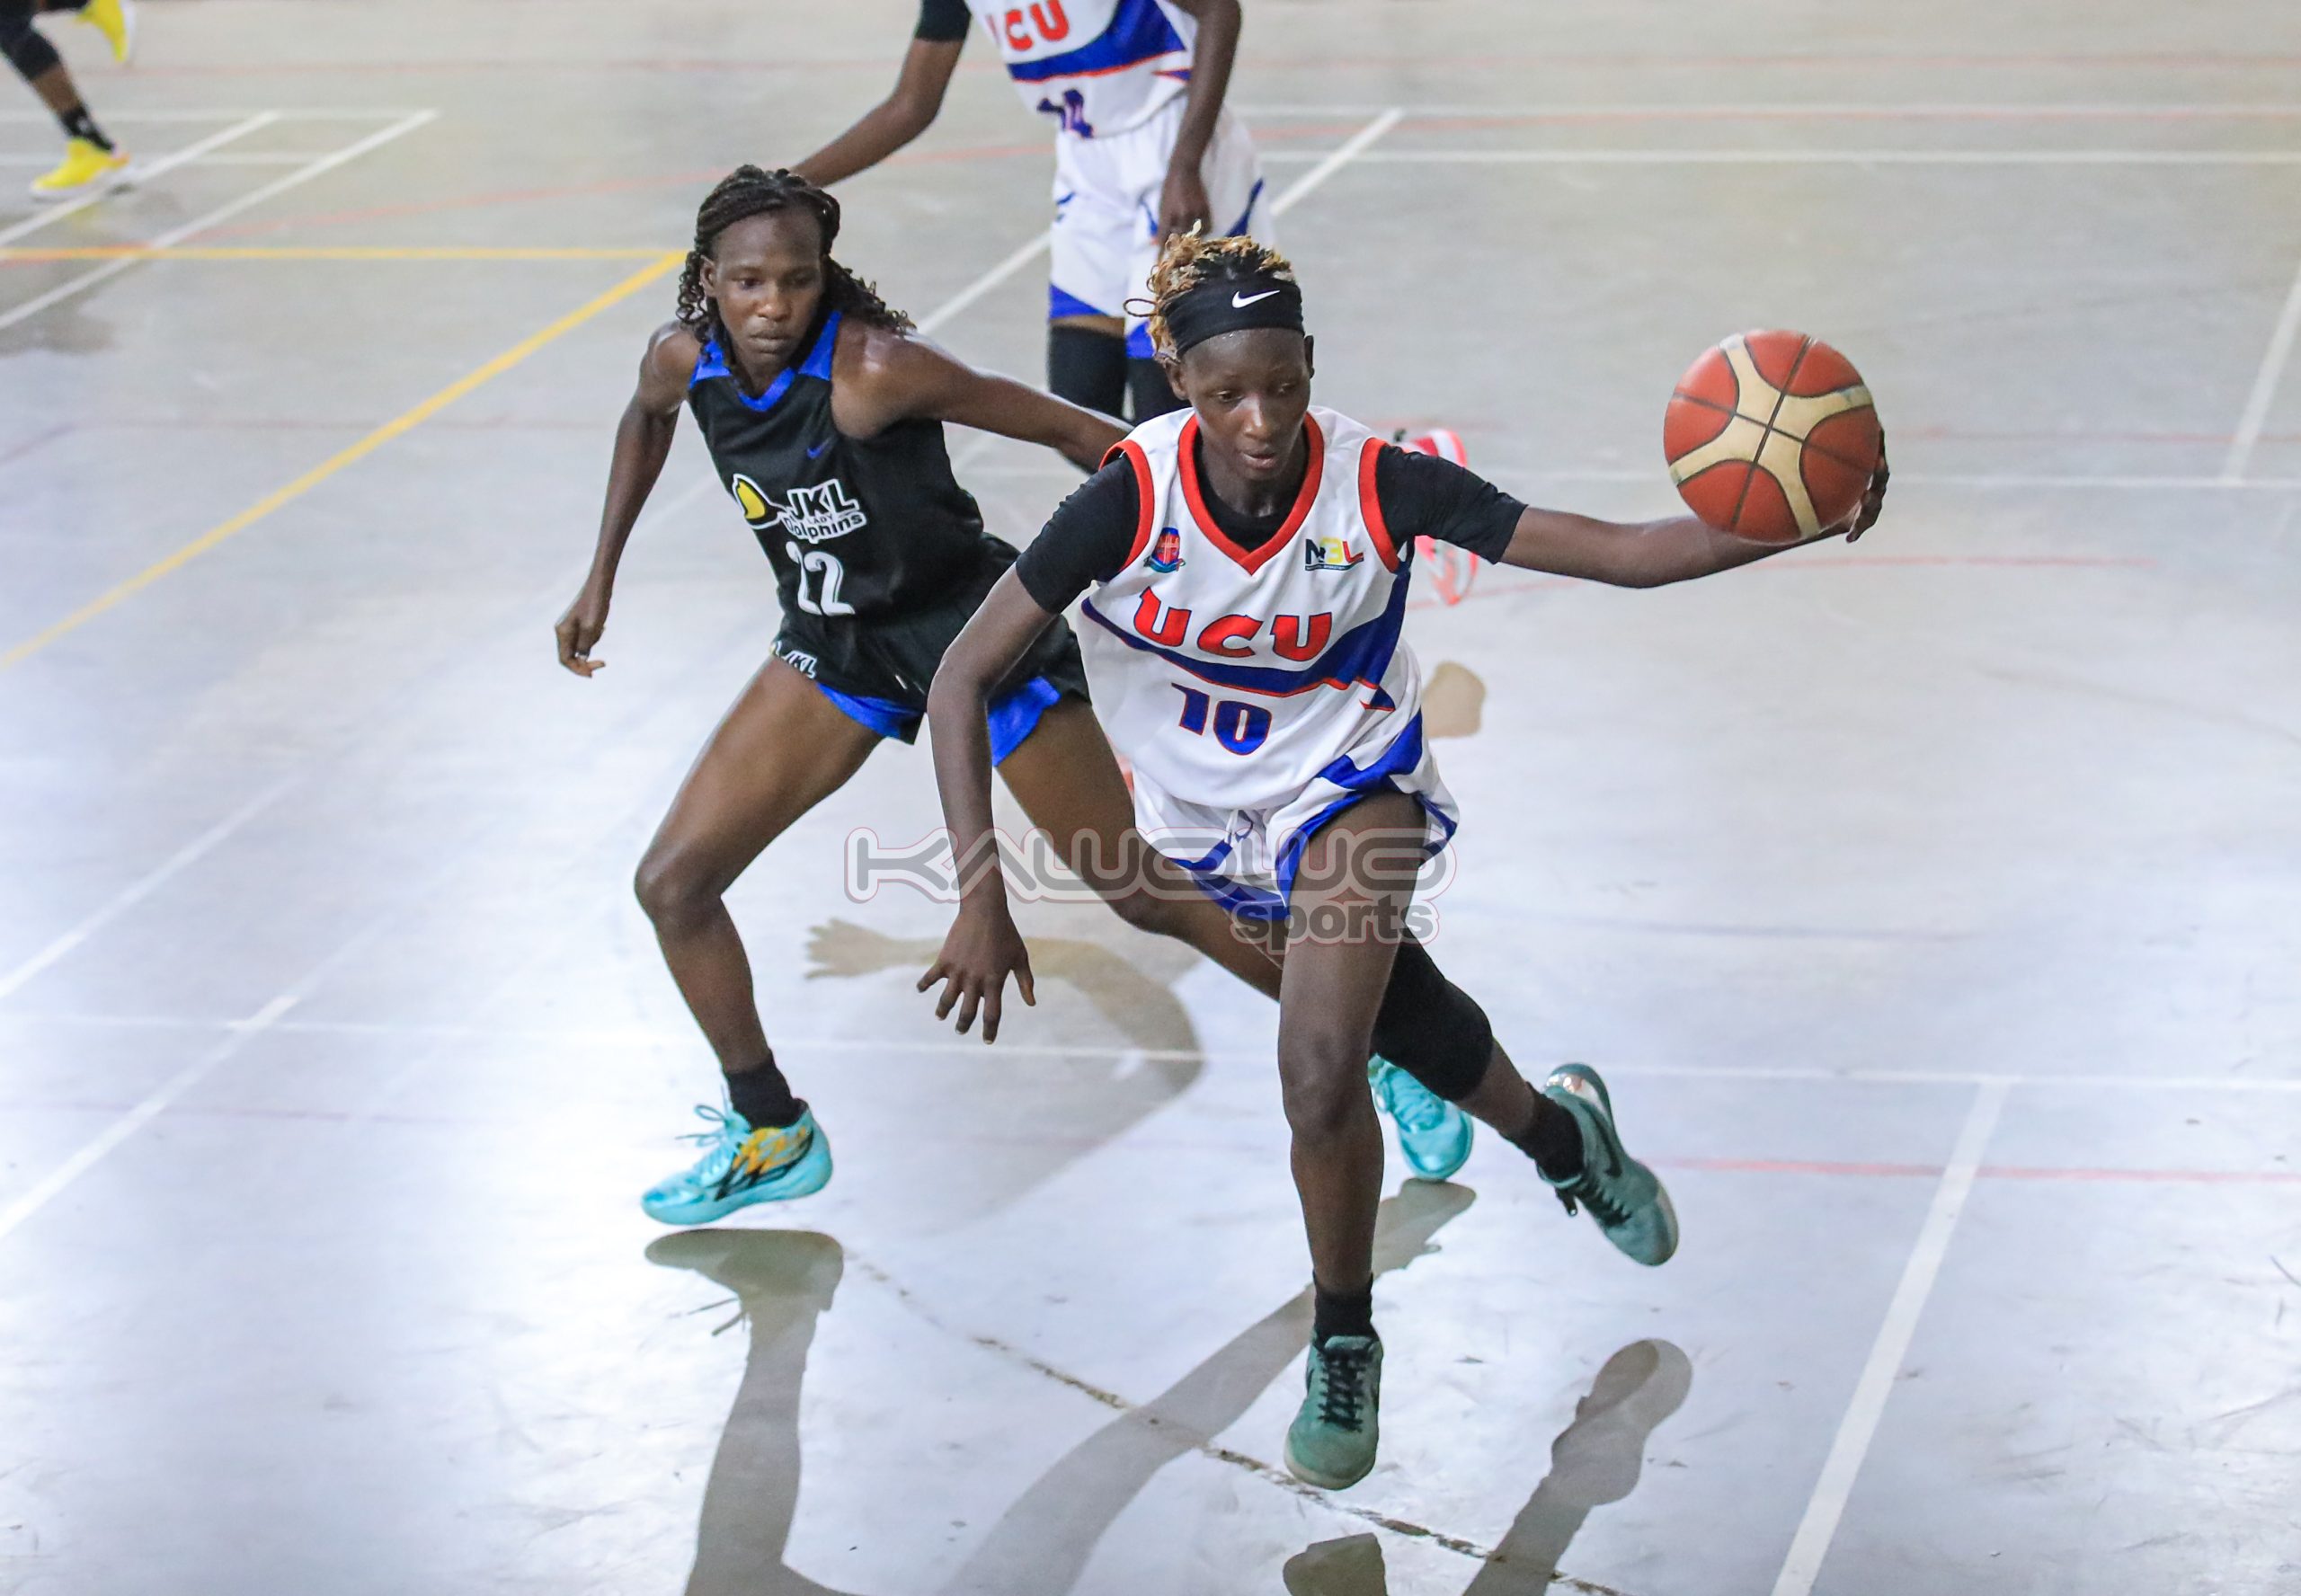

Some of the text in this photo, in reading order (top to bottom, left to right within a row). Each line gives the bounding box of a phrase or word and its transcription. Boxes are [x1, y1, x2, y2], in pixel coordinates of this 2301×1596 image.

[986, 0, 1070, 52] CU
[783, 514, 864, 541] Dolphins
[787, 479, 859, 521] JKL
[786, 541, 855, 616] 12
[1133, 586, 1333, 662] UCU
[1171, 681, 1273, 756] 10
